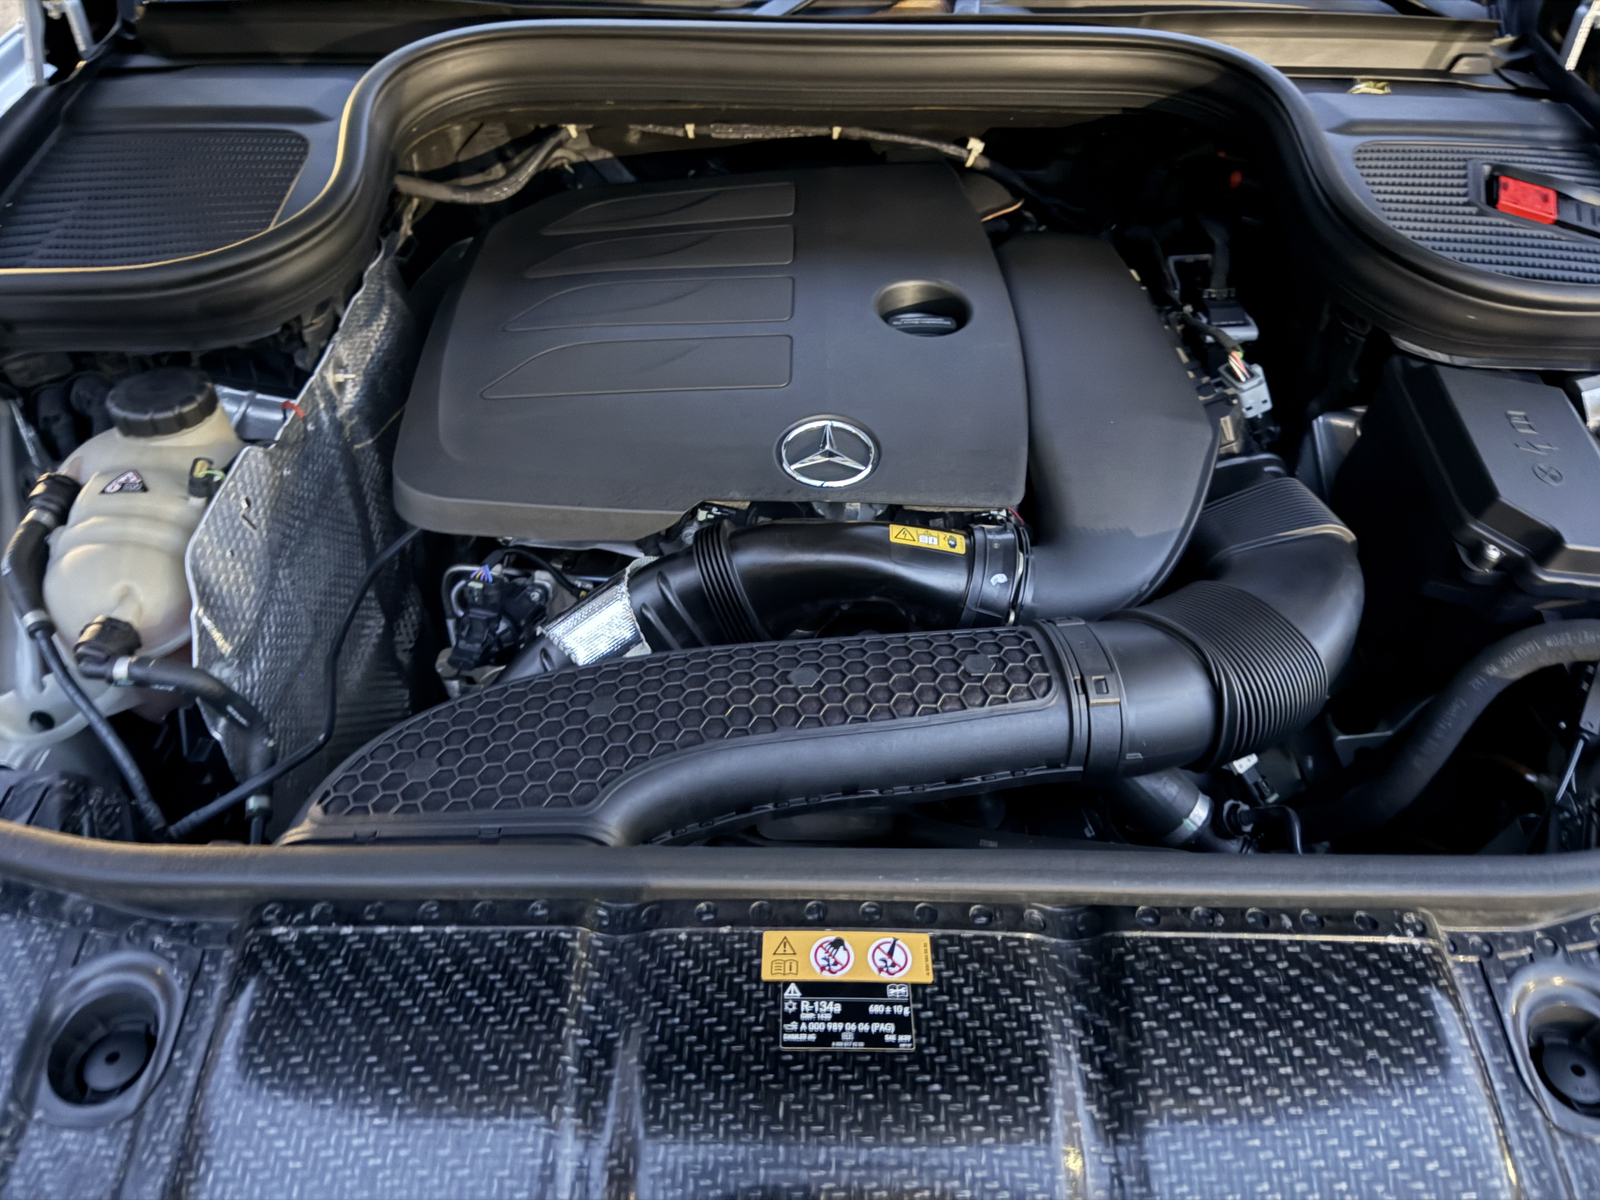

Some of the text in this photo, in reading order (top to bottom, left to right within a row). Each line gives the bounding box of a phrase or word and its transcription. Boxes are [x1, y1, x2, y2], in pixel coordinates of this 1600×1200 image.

[800, 1000, 842, 1014] R-134a
[868, 1004, 885, 1015] 680
[893, 1005, 903, 1015] 10
[903, 1006, 910, 1017] g
[800, 1022, 895, 1034] A 000 989 06 06 (PAG)
